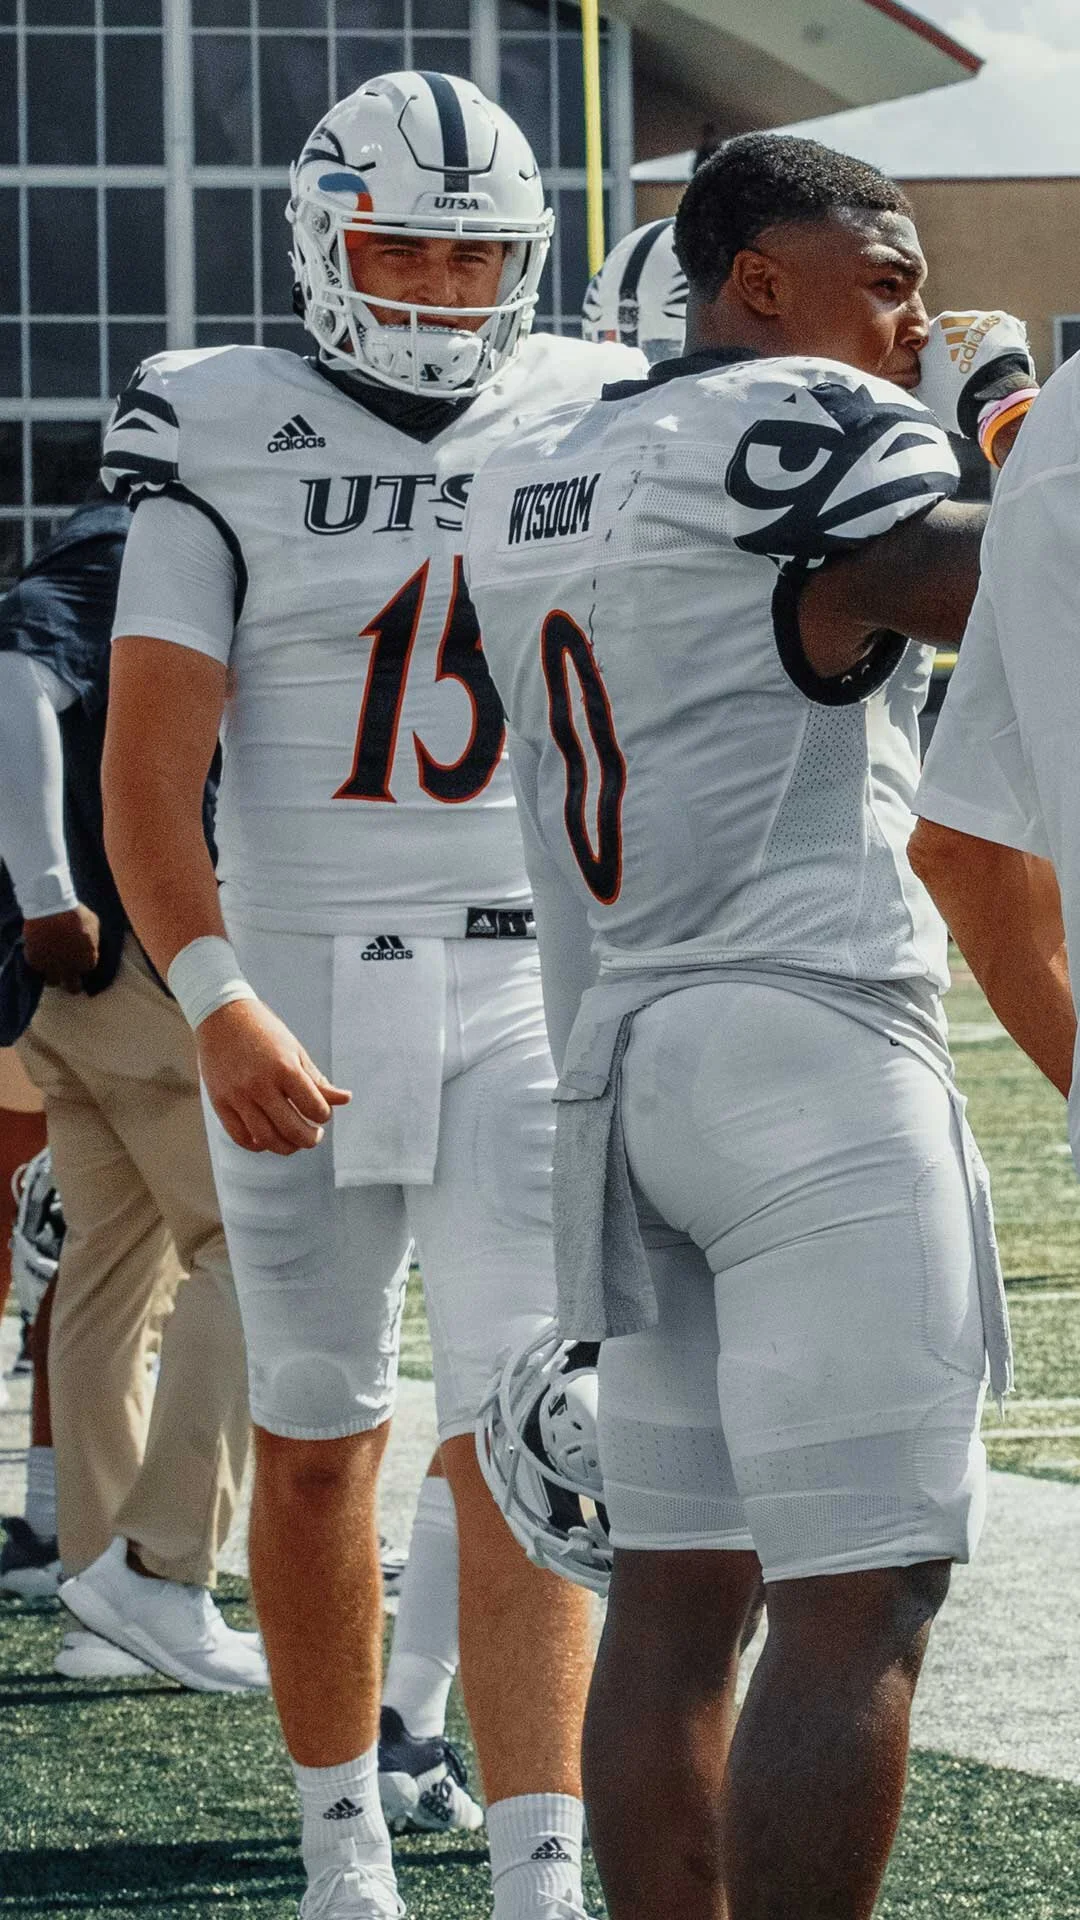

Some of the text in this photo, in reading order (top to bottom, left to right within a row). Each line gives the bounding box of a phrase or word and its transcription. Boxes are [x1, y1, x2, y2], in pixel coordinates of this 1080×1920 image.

[433, 196, 479, 210] UTSA
[267, 434, 326, 453] adidas
[508, 472, 602, 545] WISDOM
[331, 554, 509, 804] 15
[540, 608, 628, 906] 0
[360, 948, 413, 961] adidas
